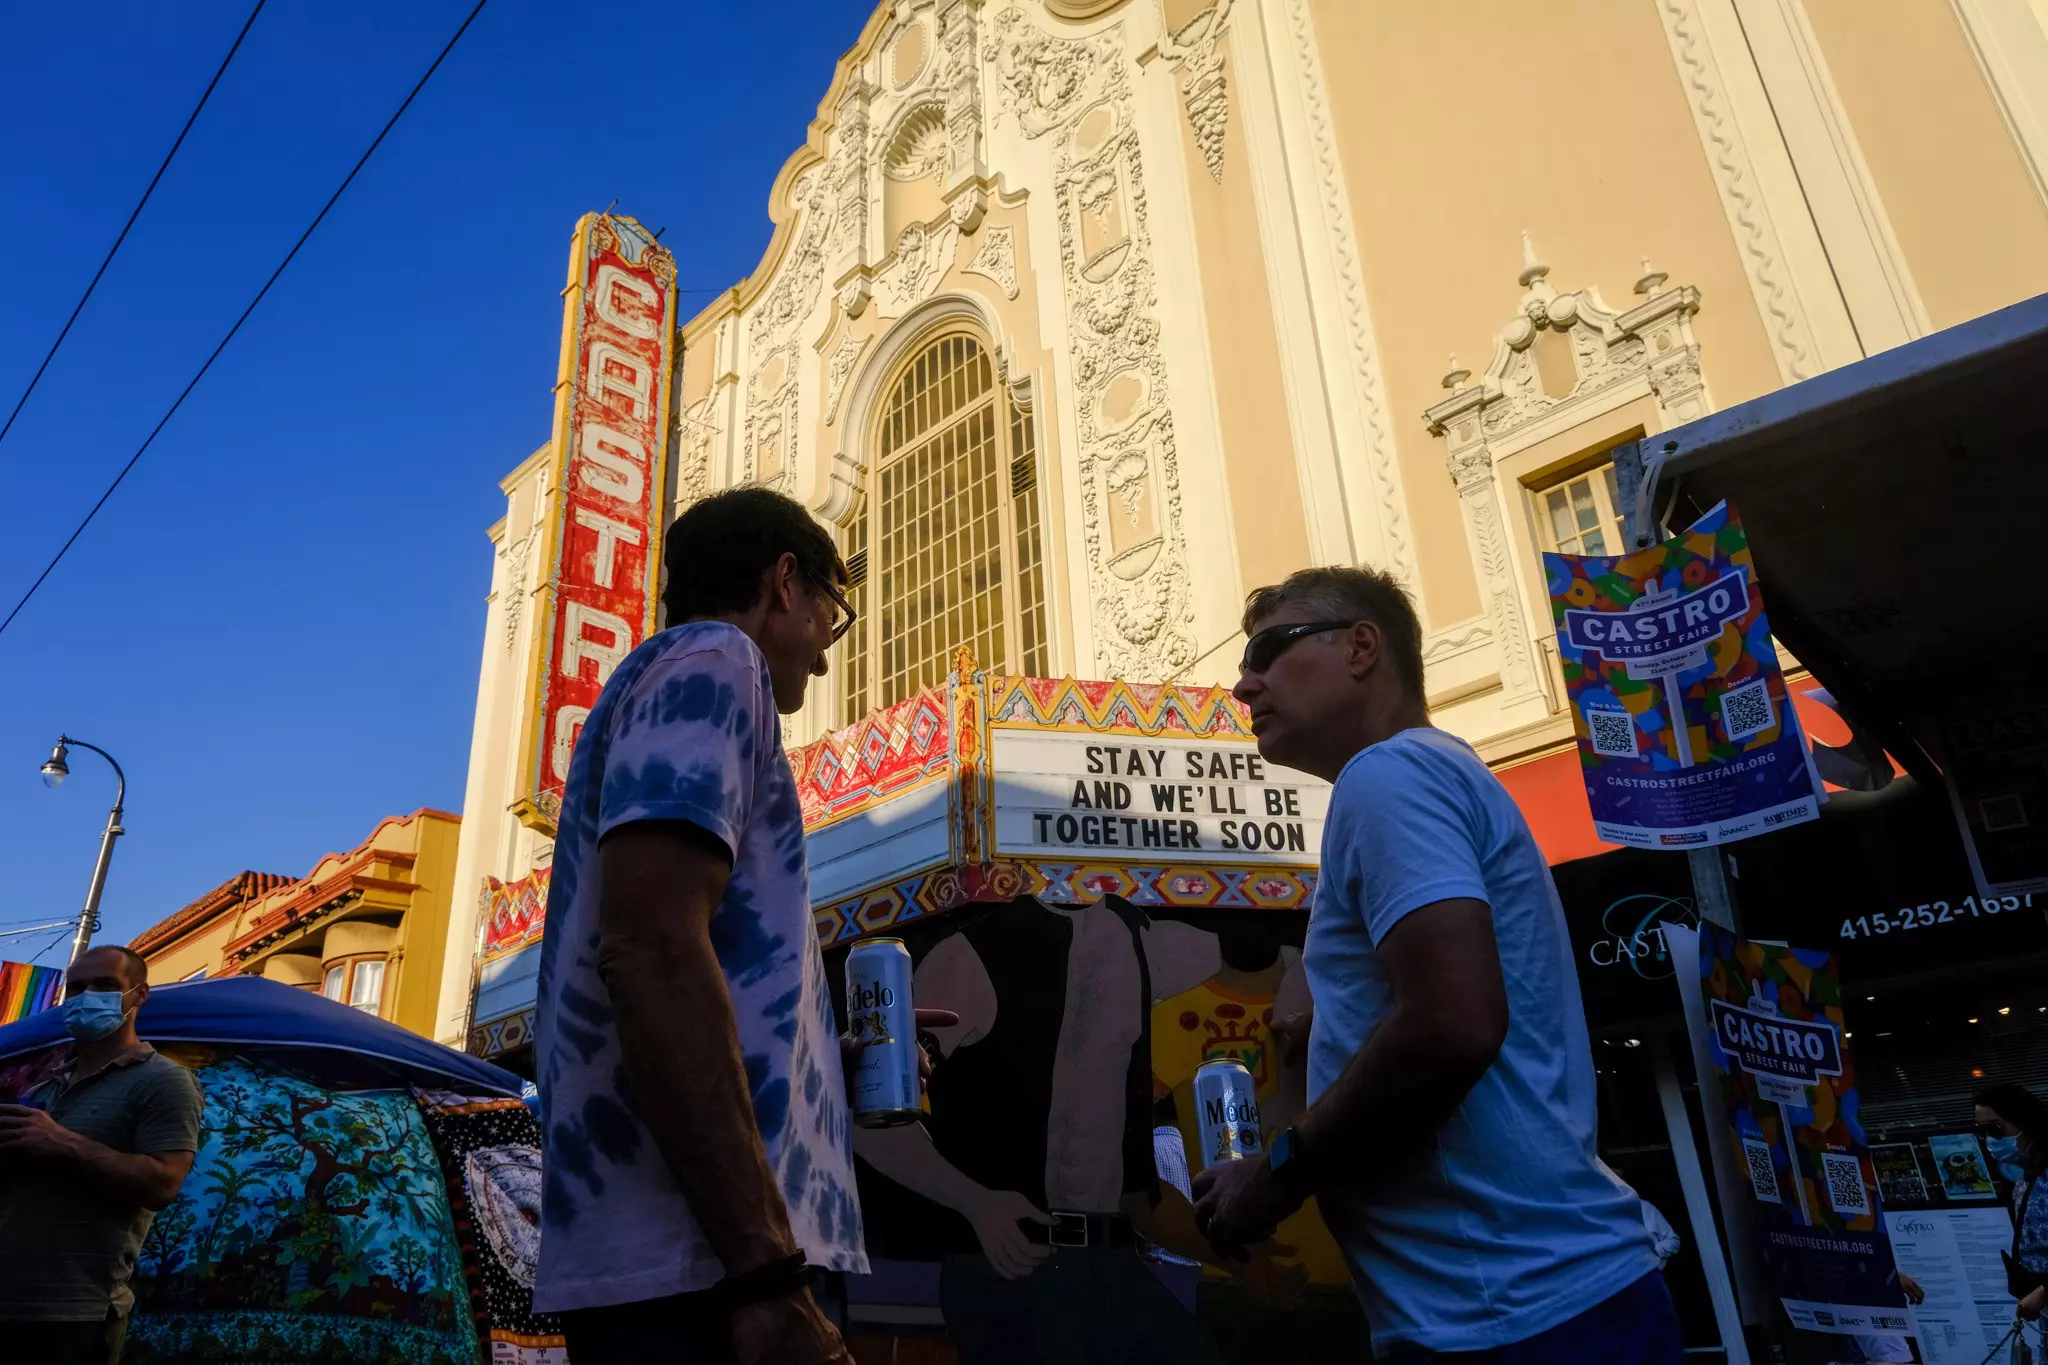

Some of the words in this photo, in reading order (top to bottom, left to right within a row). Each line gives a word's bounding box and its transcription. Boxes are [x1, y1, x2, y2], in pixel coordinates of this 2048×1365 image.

[1651, 593, 1673, 605] Annual
[1582, 588, 1731, 642] CASTRO
[1614, 638, 1671, 654] STREET
[1678, 625, 1710, 644] FAIR
[1633, 660, 1660, 671] Sunday,
[1661, 653, 1688, 665] October
[1727, 675, 1752, 689] Donate
[1085, 746, 1166, 778] STAY
[1186, 750, 1265, 781] SAFE
[1607, 752, 1776, 789] CASTROSTREETFAIR.ORG
[1071, 779, 1132, 810] AND
[1150, 784, 1246, 815] WE'LL
[1264, 788, 1301, 816] BE
[1782, 805, 1808, 819] TIMES
[1034, 813, 1201, 848] TOGETHER
[1220, 820, 1306, 852] SOON
[1719, 825, 1749, 837] ADVANCE
[1590, 921, 1701, 966] CAST
[849, 980, 895, 1011] delo
[1723, 1012, 1825, 1061] CASTRO
[1745, 1052, 1778, 1069] STREET
[1783, 1061, 1807, 1075] FAIR
[1825, 1143, 1847, 1152] Donate
[1895, 1221, 1934, 1234] CASTRO
[1769, 1231, 1874, 1255] CASTROSTREETFAIR.ORG
